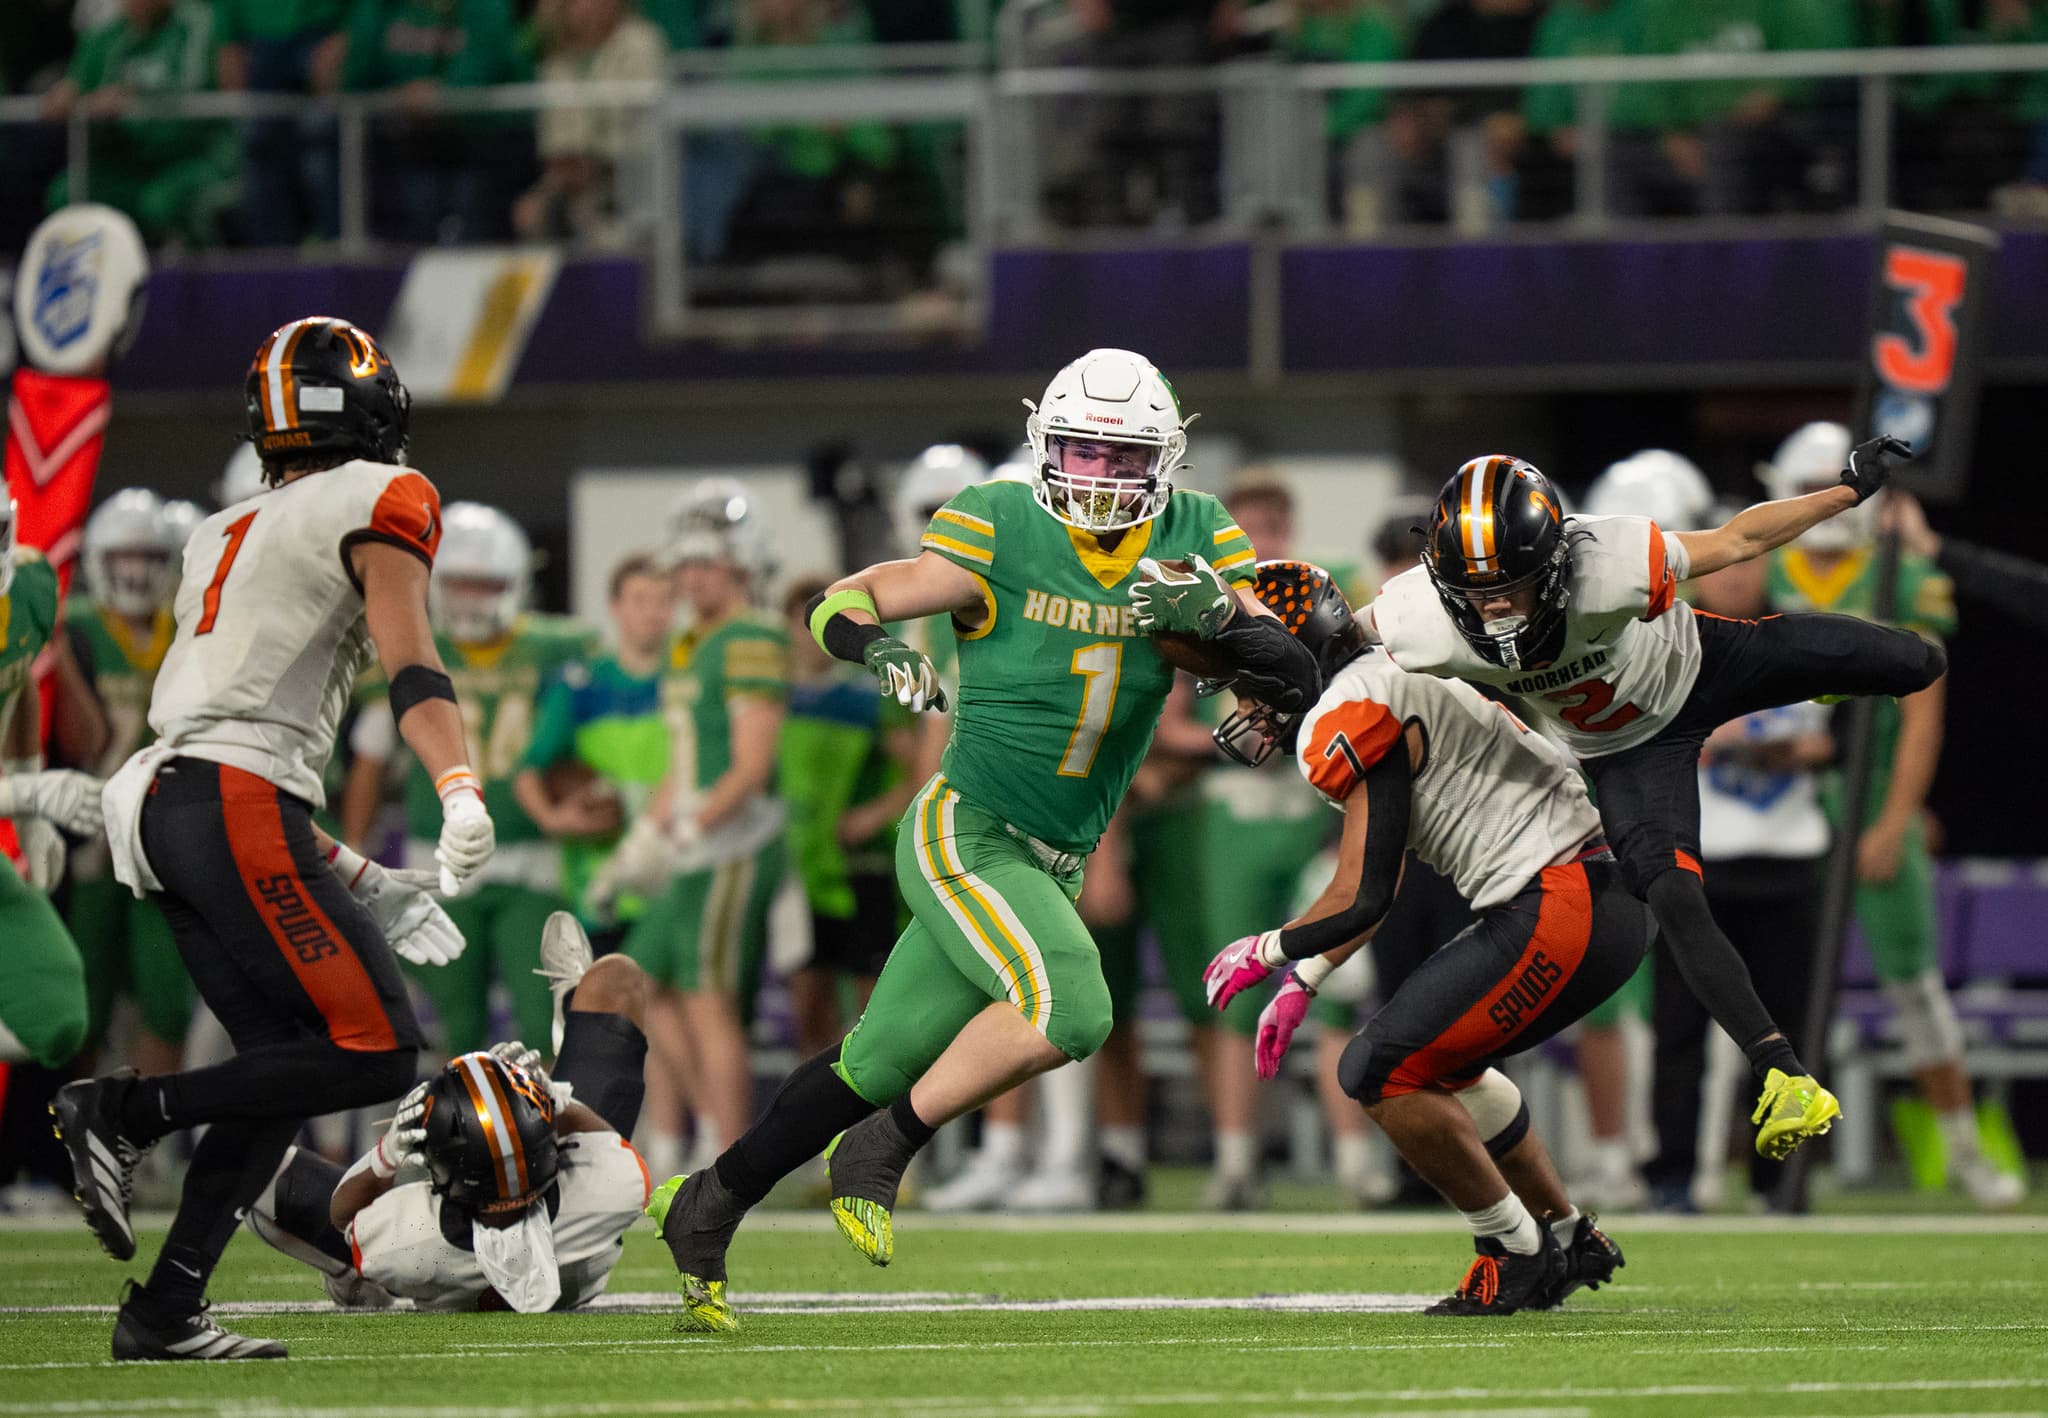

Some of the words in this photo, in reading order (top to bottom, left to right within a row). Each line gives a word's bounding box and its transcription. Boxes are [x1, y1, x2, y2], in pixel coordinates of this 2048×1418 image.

[1873, 246, 1967, 392] 3
[194, 507, 260, 637] 1
[1023, 588, 1150, 638] HORNE
[1056, 641, 1123, 778] 1
[1506, 650, 1607, 694] MOORHEAD
[1541, 678, 1642, 732] 2
[1323, 730, 1366, 779] 7
[255, 874, 339, 963] SPUDS
[1488, 950, 1563, 1033] SPUDS
